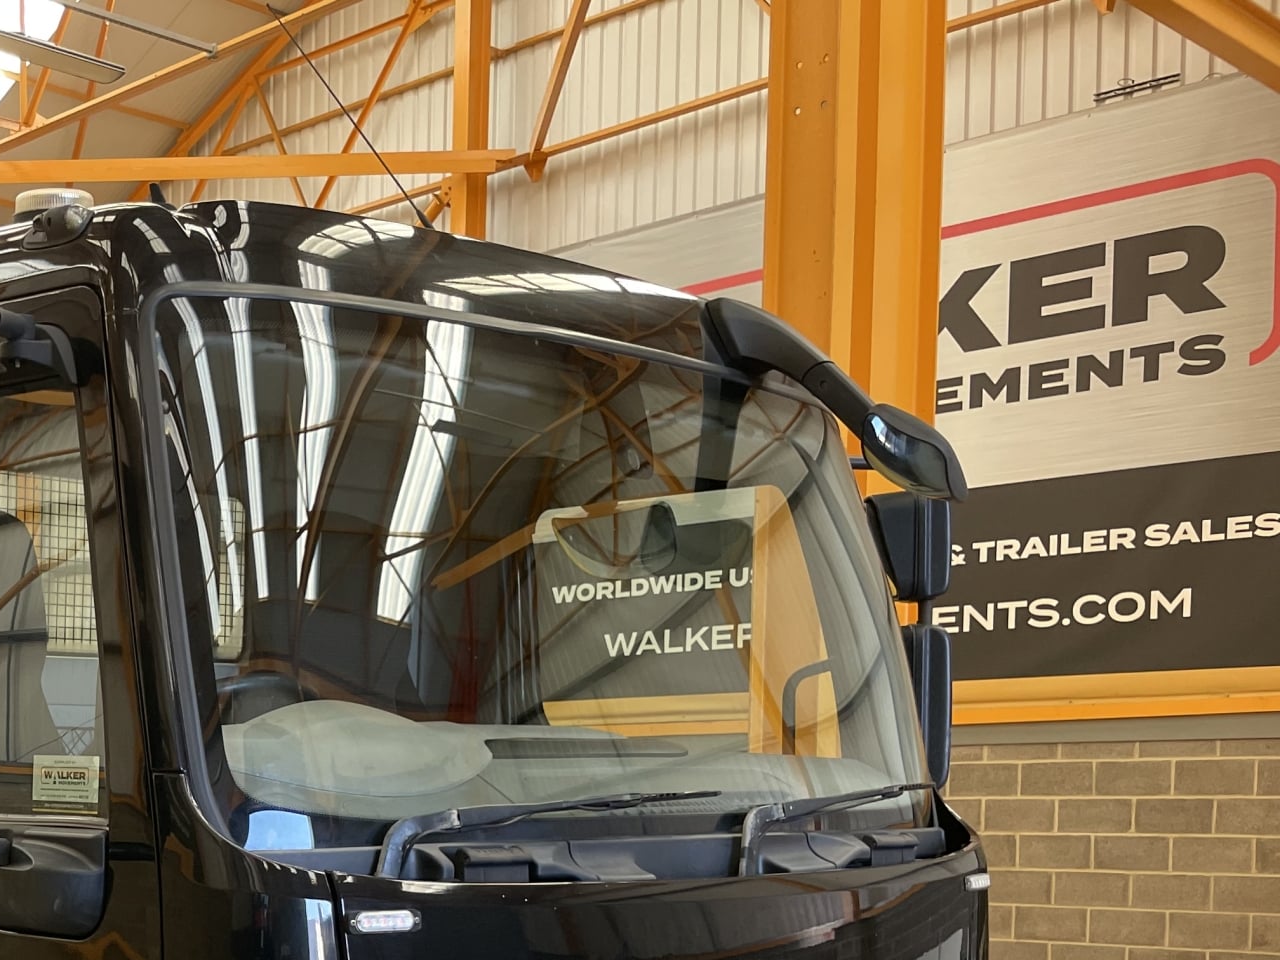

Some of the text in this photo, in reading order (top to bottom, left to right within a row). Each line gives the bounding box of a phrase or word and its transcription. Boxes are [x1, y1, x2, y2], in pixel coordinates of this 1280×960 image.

[972, 527, 1137, 563] TRAILER
[1144, 512, 1280, 546] SALES
[552, 567, 753, 604] WORLDWIDE U
[44, 770, 87, 782] WALKER
